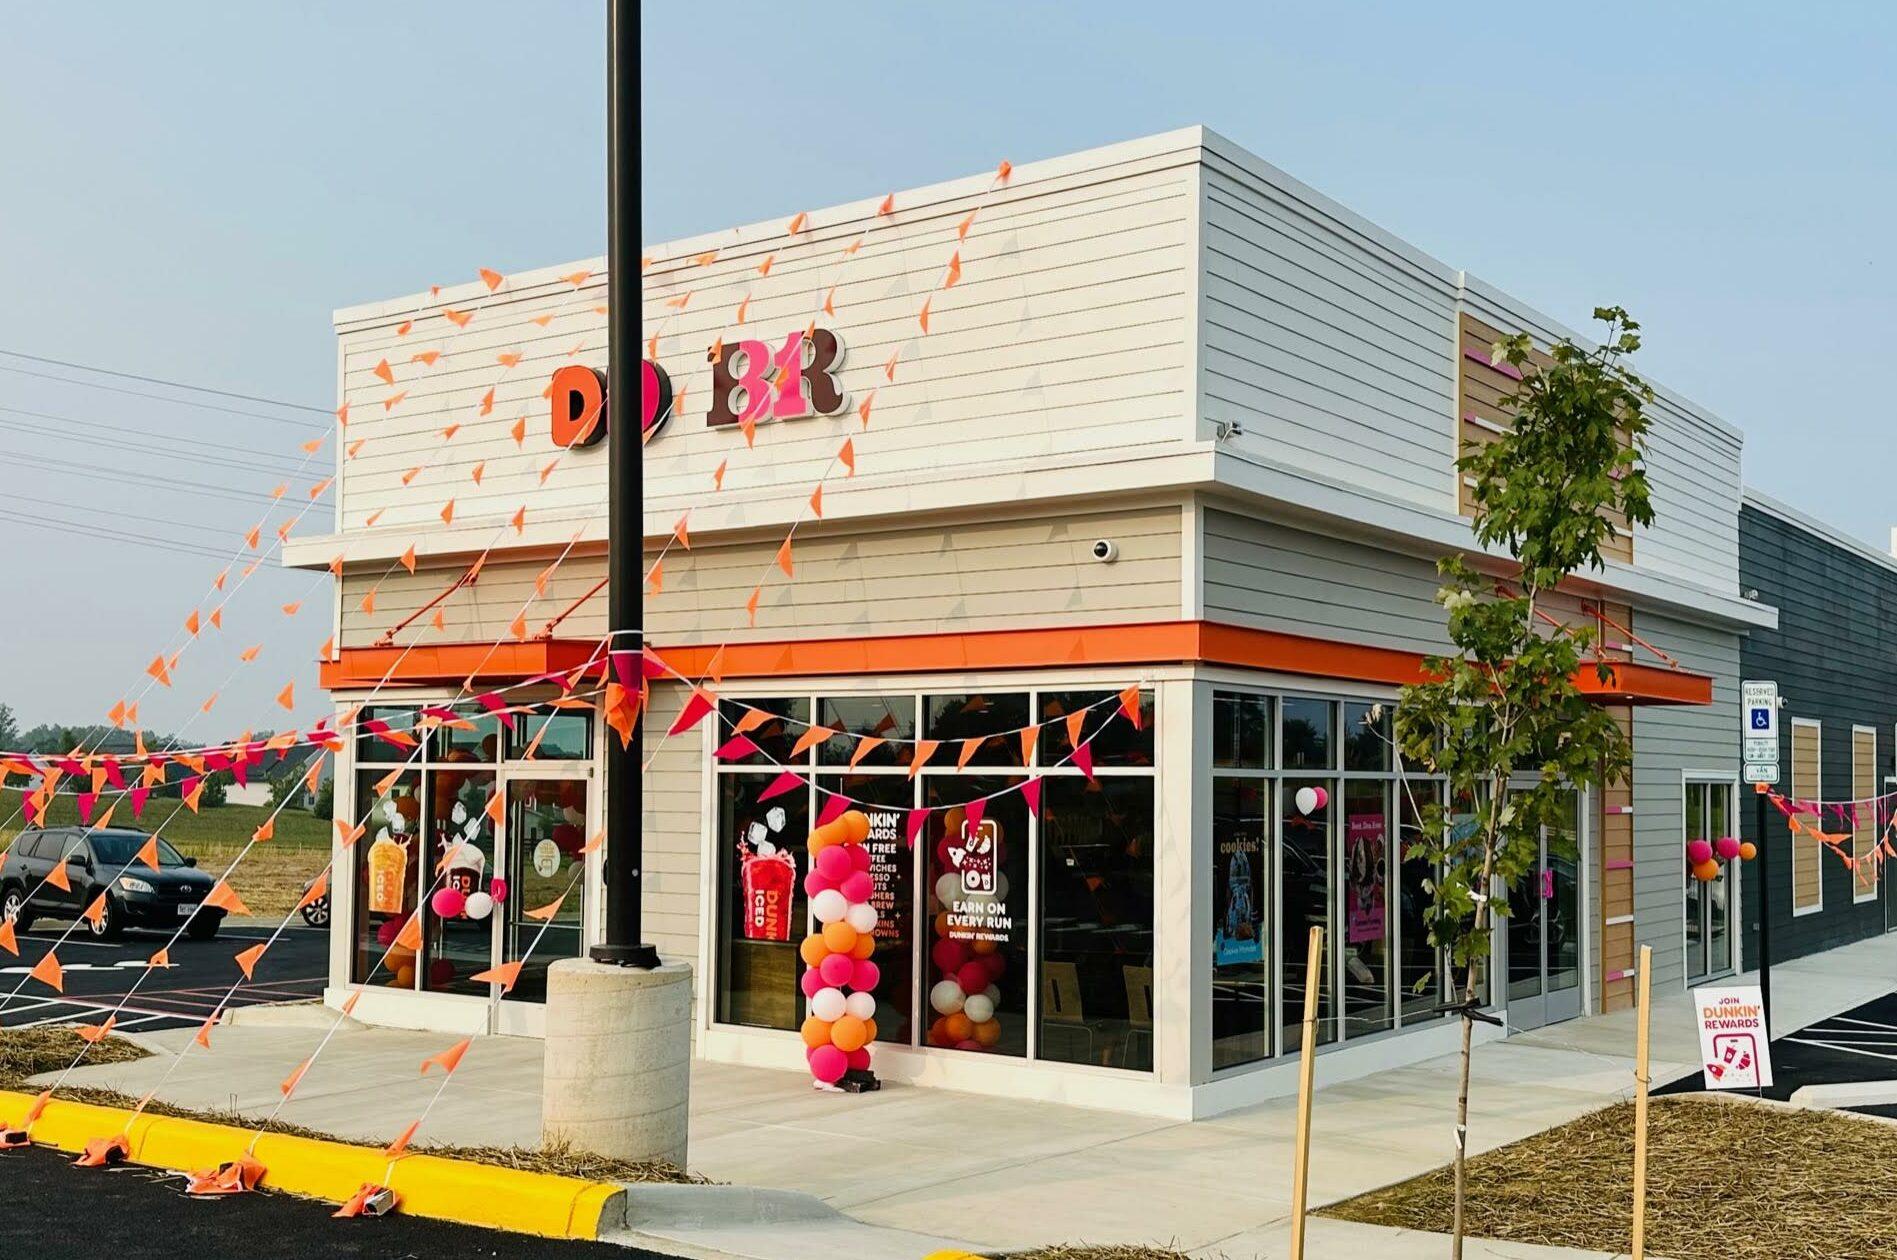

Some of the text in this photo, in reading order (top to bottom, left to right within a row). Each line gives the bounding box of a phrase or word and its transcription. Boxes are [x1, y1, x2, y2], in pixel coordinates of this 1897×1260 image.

[1747, 698, 1773, 707] PARKING
[867, 828, 897, 840] ARDS
[872, 843, 897, 854] FREE
[755, 889, 765, 928] ICED
[952, 900, 1006, 915] EARN ON
[946, 914, 1012, 930] EVERY RUN
[975, 932, 1009, 942] REWARDS
[1719, 997, 1740, 1005] JOIN
[1703, 1005, 1761, 1018] DUNKIN'
[1705, 1018, 1759, 1030] REWARDS
